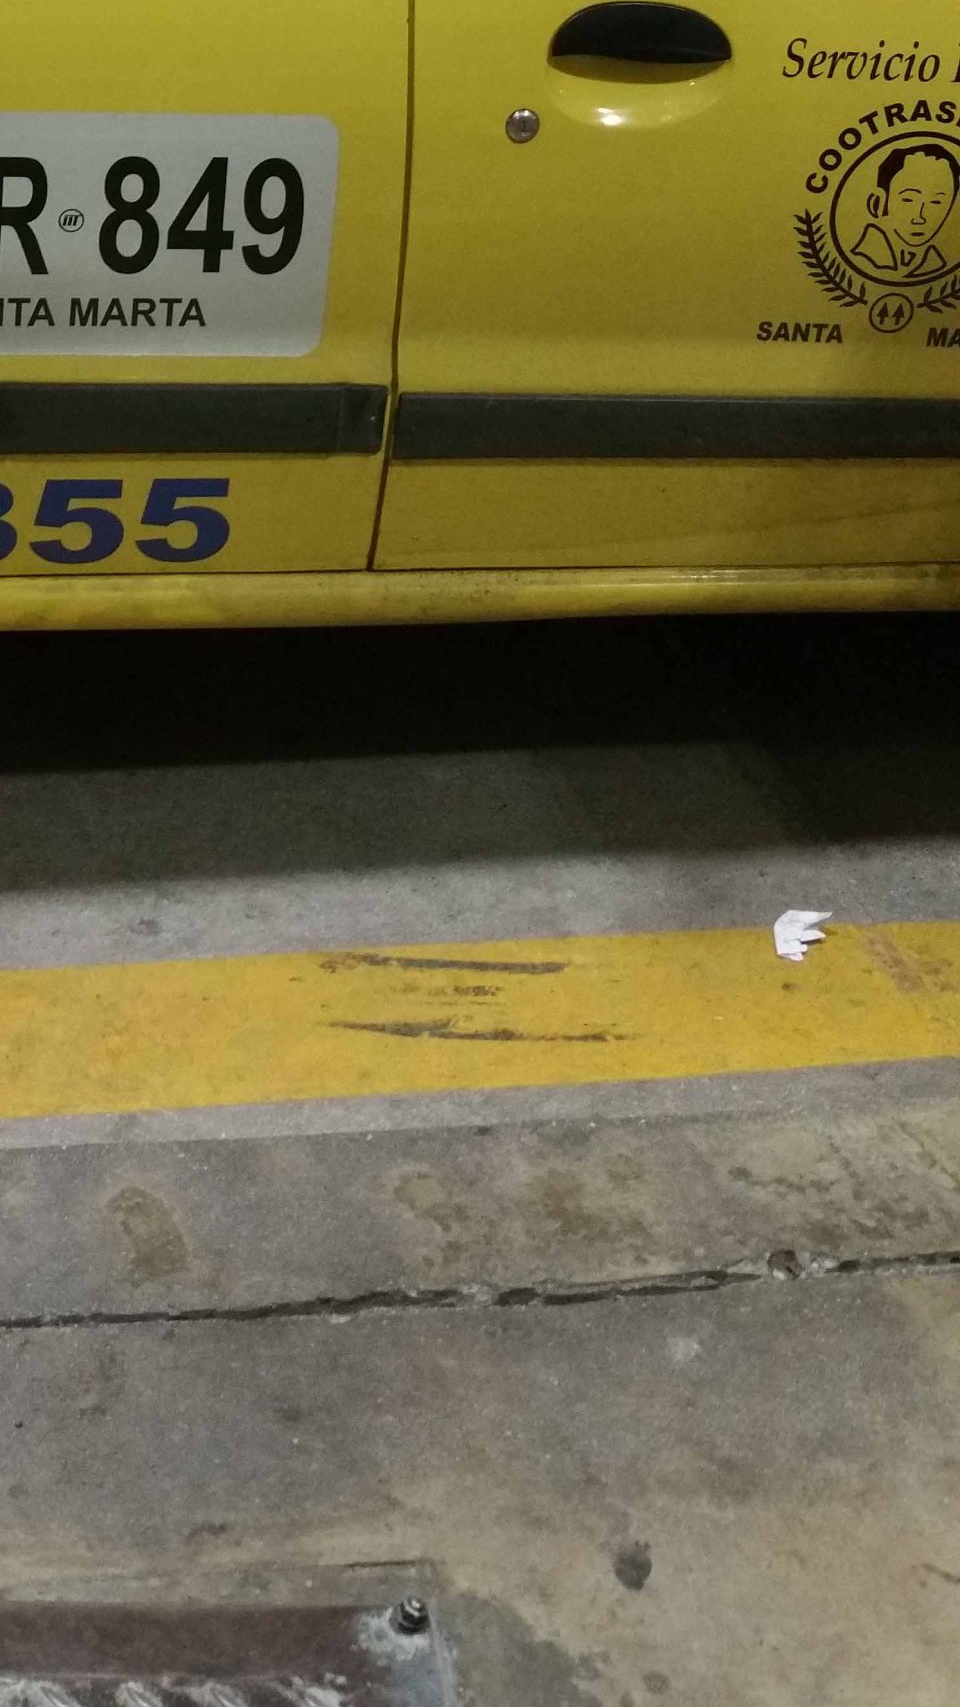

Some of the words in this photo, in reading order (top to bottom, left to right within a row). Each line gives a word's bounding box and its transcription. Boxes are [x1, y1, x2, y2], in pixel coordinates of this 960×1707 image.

[781, 37, 941, 83] Servicio
[805, 99, 960, 194] COOTRAS
[98, 156, 305, 275] 849
[69, 297, 206, 327] MARTA
[756, 321, 843, 344] SANTA
